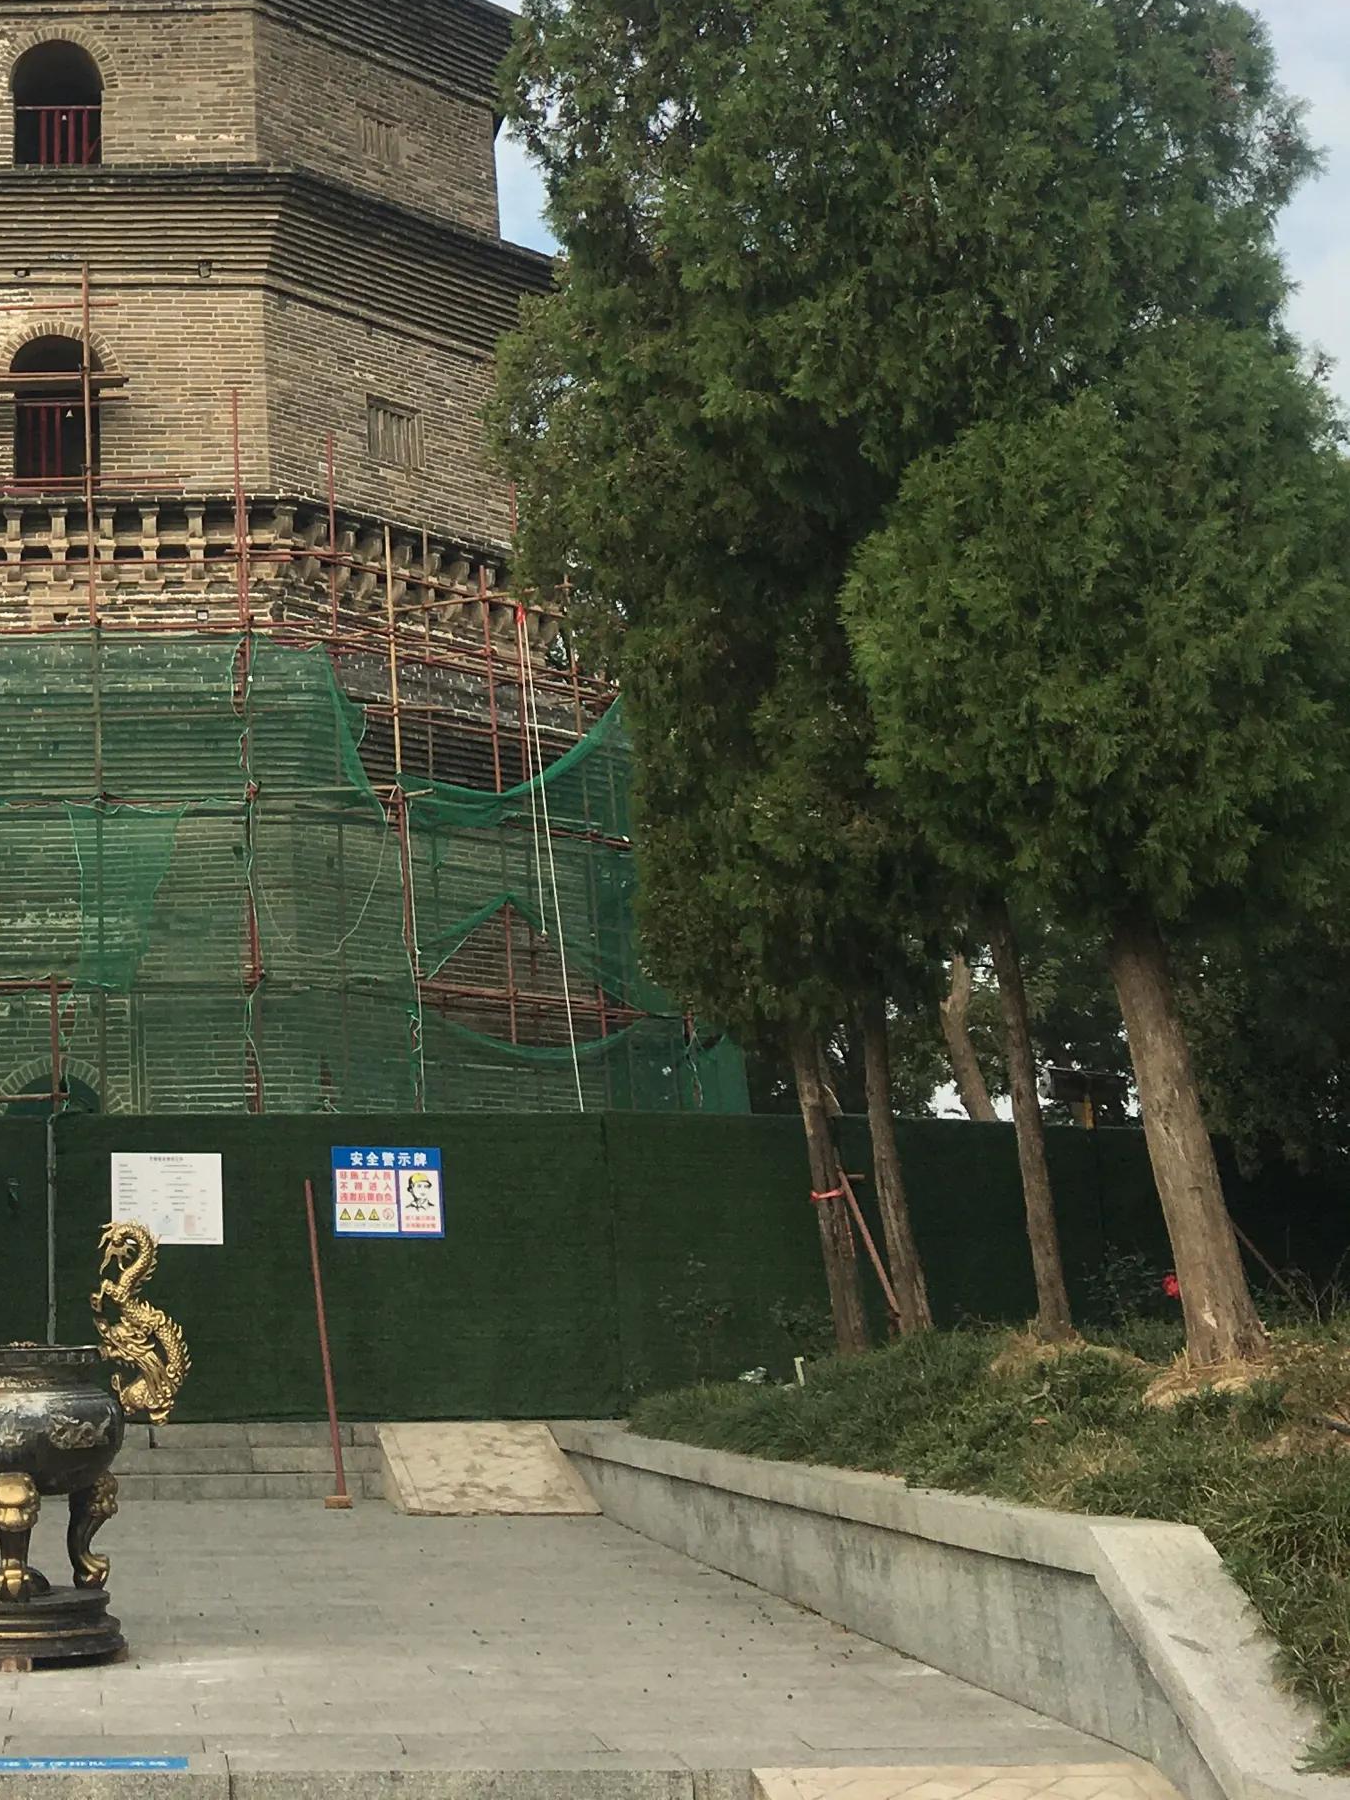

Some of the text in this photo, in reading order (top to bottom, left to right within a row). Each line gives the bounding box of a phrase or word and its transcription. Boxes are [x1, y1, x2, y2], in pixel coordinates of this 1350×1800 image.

[350, 1151, 427, 1166] 安全警示牌
[340, 1182, 392, 1191] 不得进入
